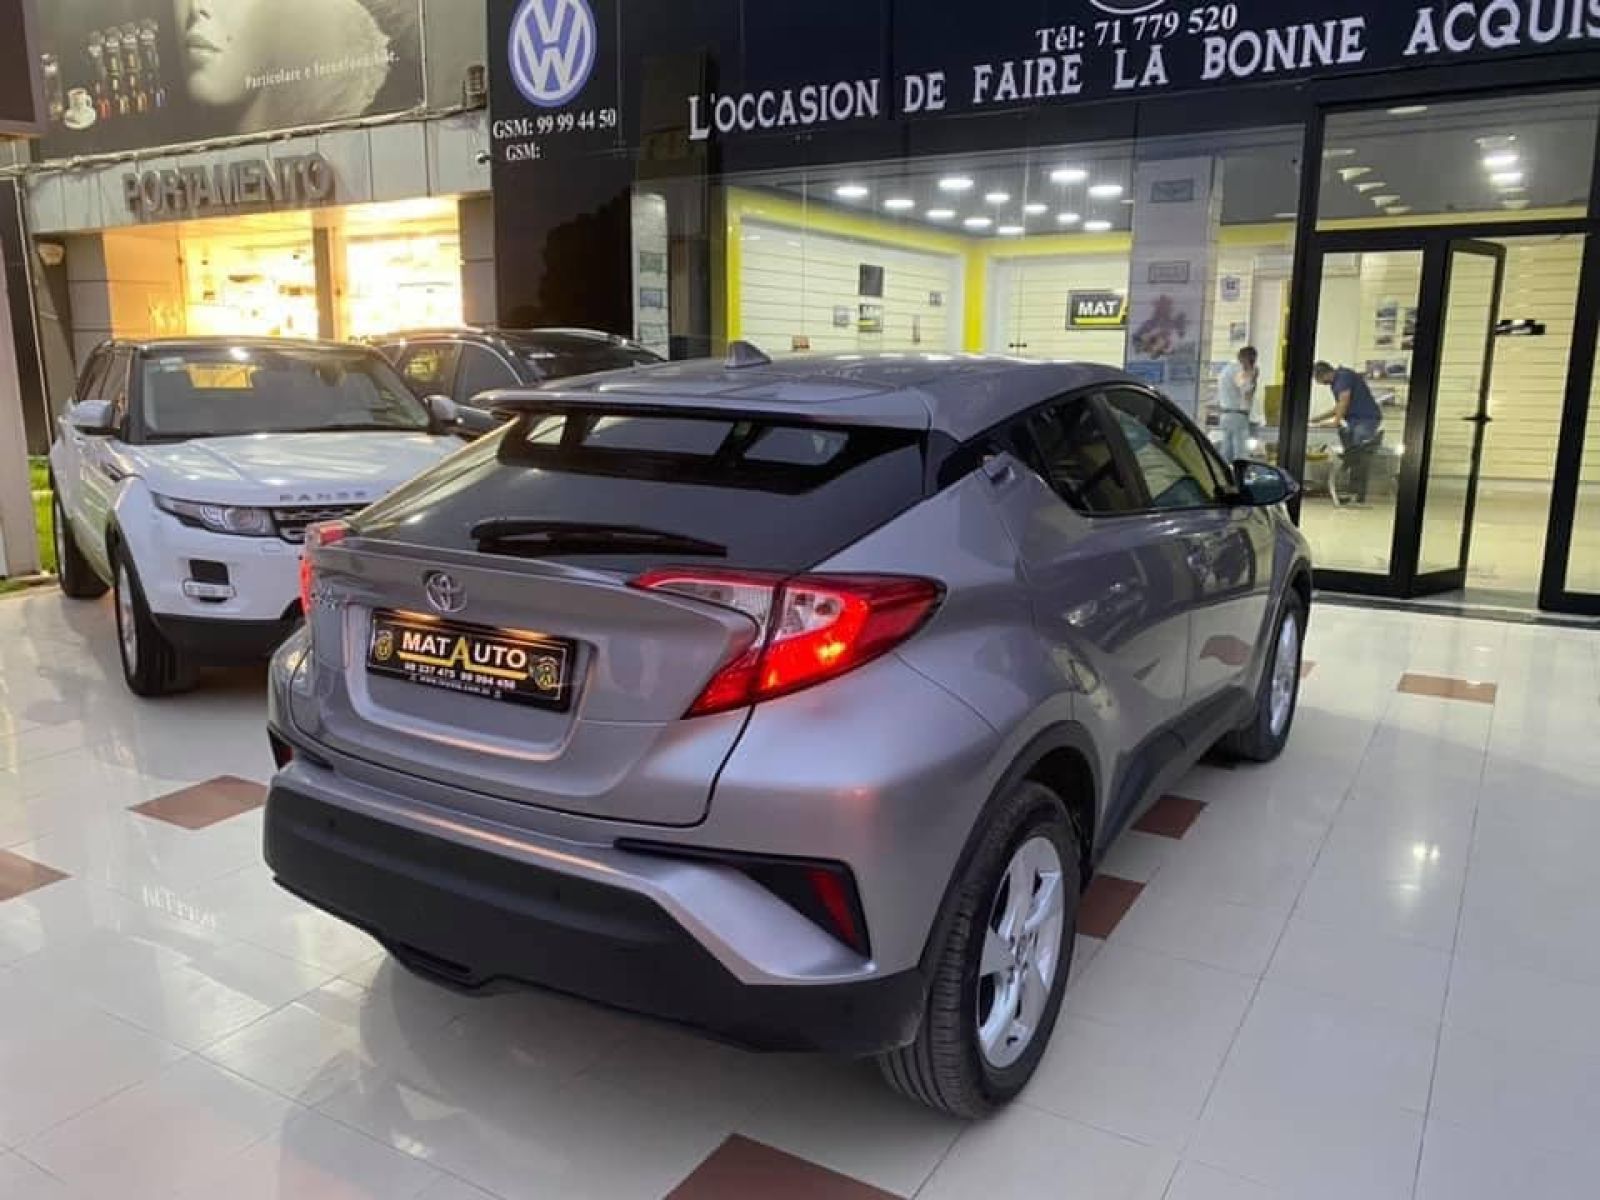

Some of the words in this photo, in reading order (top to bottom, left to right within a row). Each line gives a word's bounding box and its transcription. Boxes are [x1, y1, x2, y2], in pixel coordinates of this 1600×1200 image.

[1035, 25, 1085, 53] Tél:
[1094, 20, 1122, 46] 71
[1132, 11, 1180, 41] 779
[1188, 3, 1238, 34] 520
[687, 77, 881, 141] L'OCCASION
[902, 71, 947, 113] DE
[973, 53, 1083, 104] FAIRE
[1112, 44, 1169, 91] LA
[1200, 16, 1367, 81] BONNE
[492, 117, 534, 139] GSM:
[536, 114, 554, 135] 99
[557, 112, 574, 133] 99
[577, 108, 595, 131] 44
[599, 107, 616, 129] 50
[506, 142, 541, 161] GSM:
[121, 153, 336, 215] PORTAMENTO
[1077, 300, 1119, 316] MAT
[402, 630, 451, 656] MAT
[450, 636, 527, 671] AUTO
